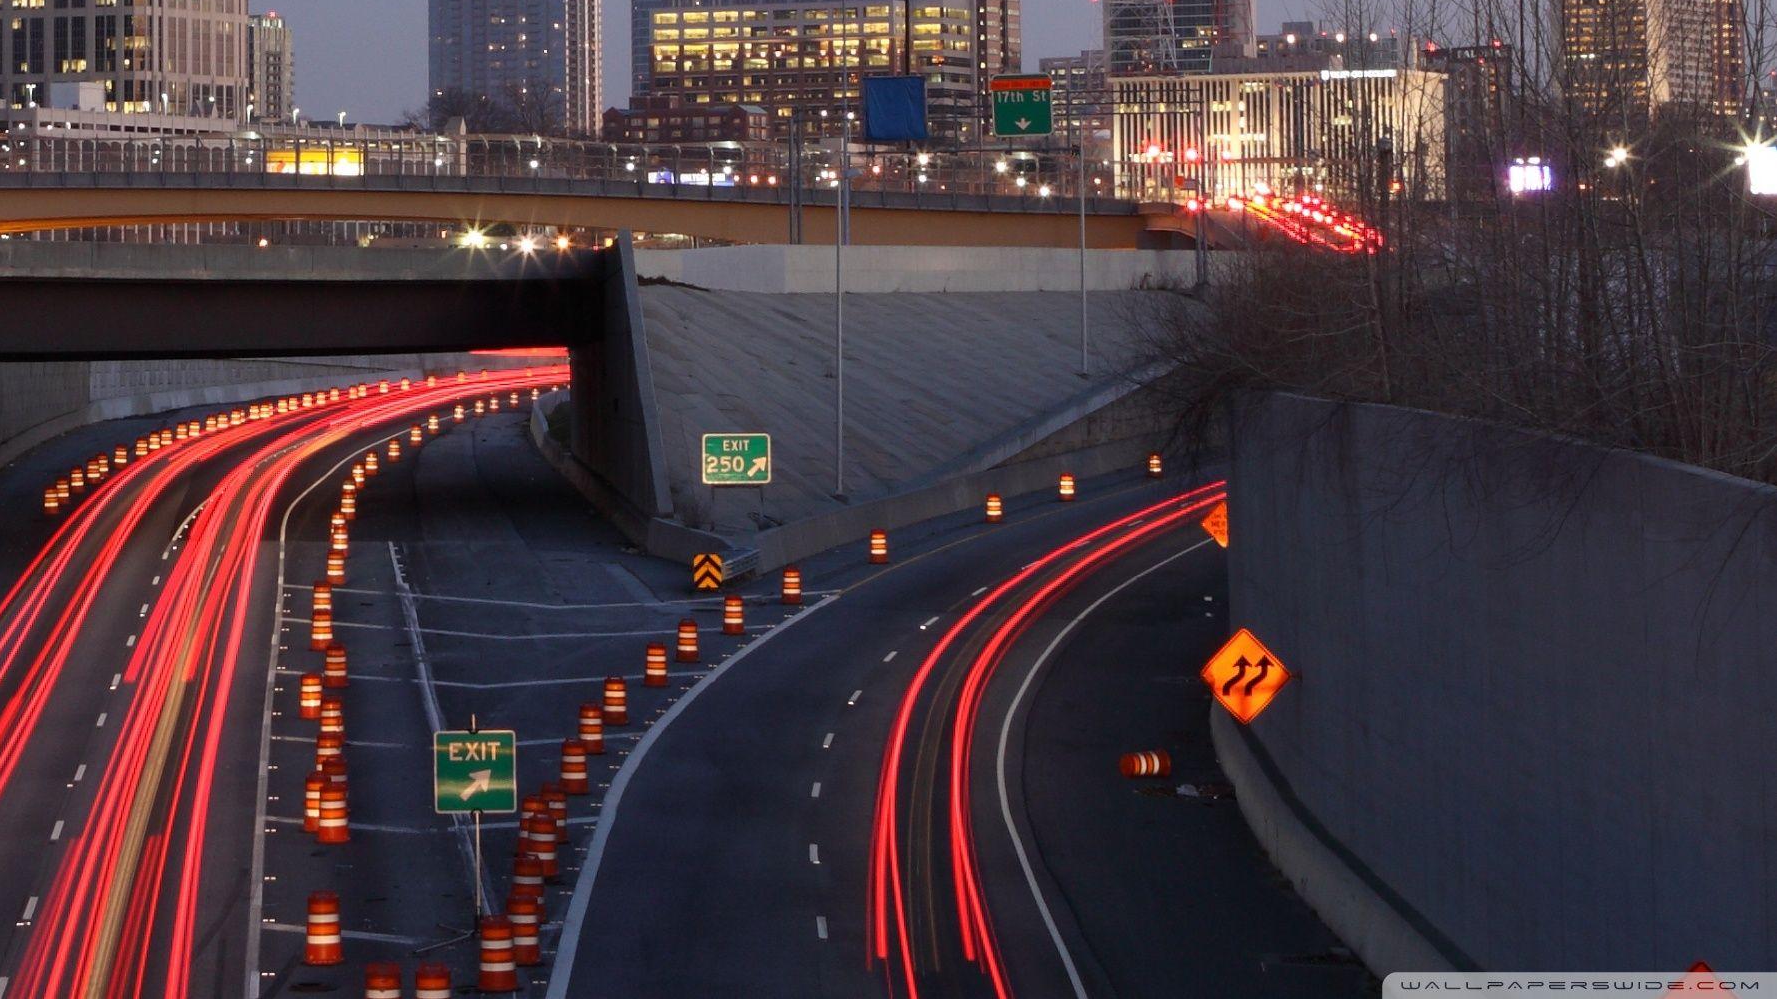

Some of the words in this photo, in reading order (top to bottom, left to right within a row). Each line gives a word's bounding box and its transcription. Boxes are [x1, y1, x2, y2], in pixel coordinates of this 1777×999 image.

[997, 90, 1024, 103] 17th
[1032, 90, 1047, 102] St
[723, 440, 750, 451] EXIT
[706, 455, 745, 473] 250
[449, 742, 501, 761] EXIT
